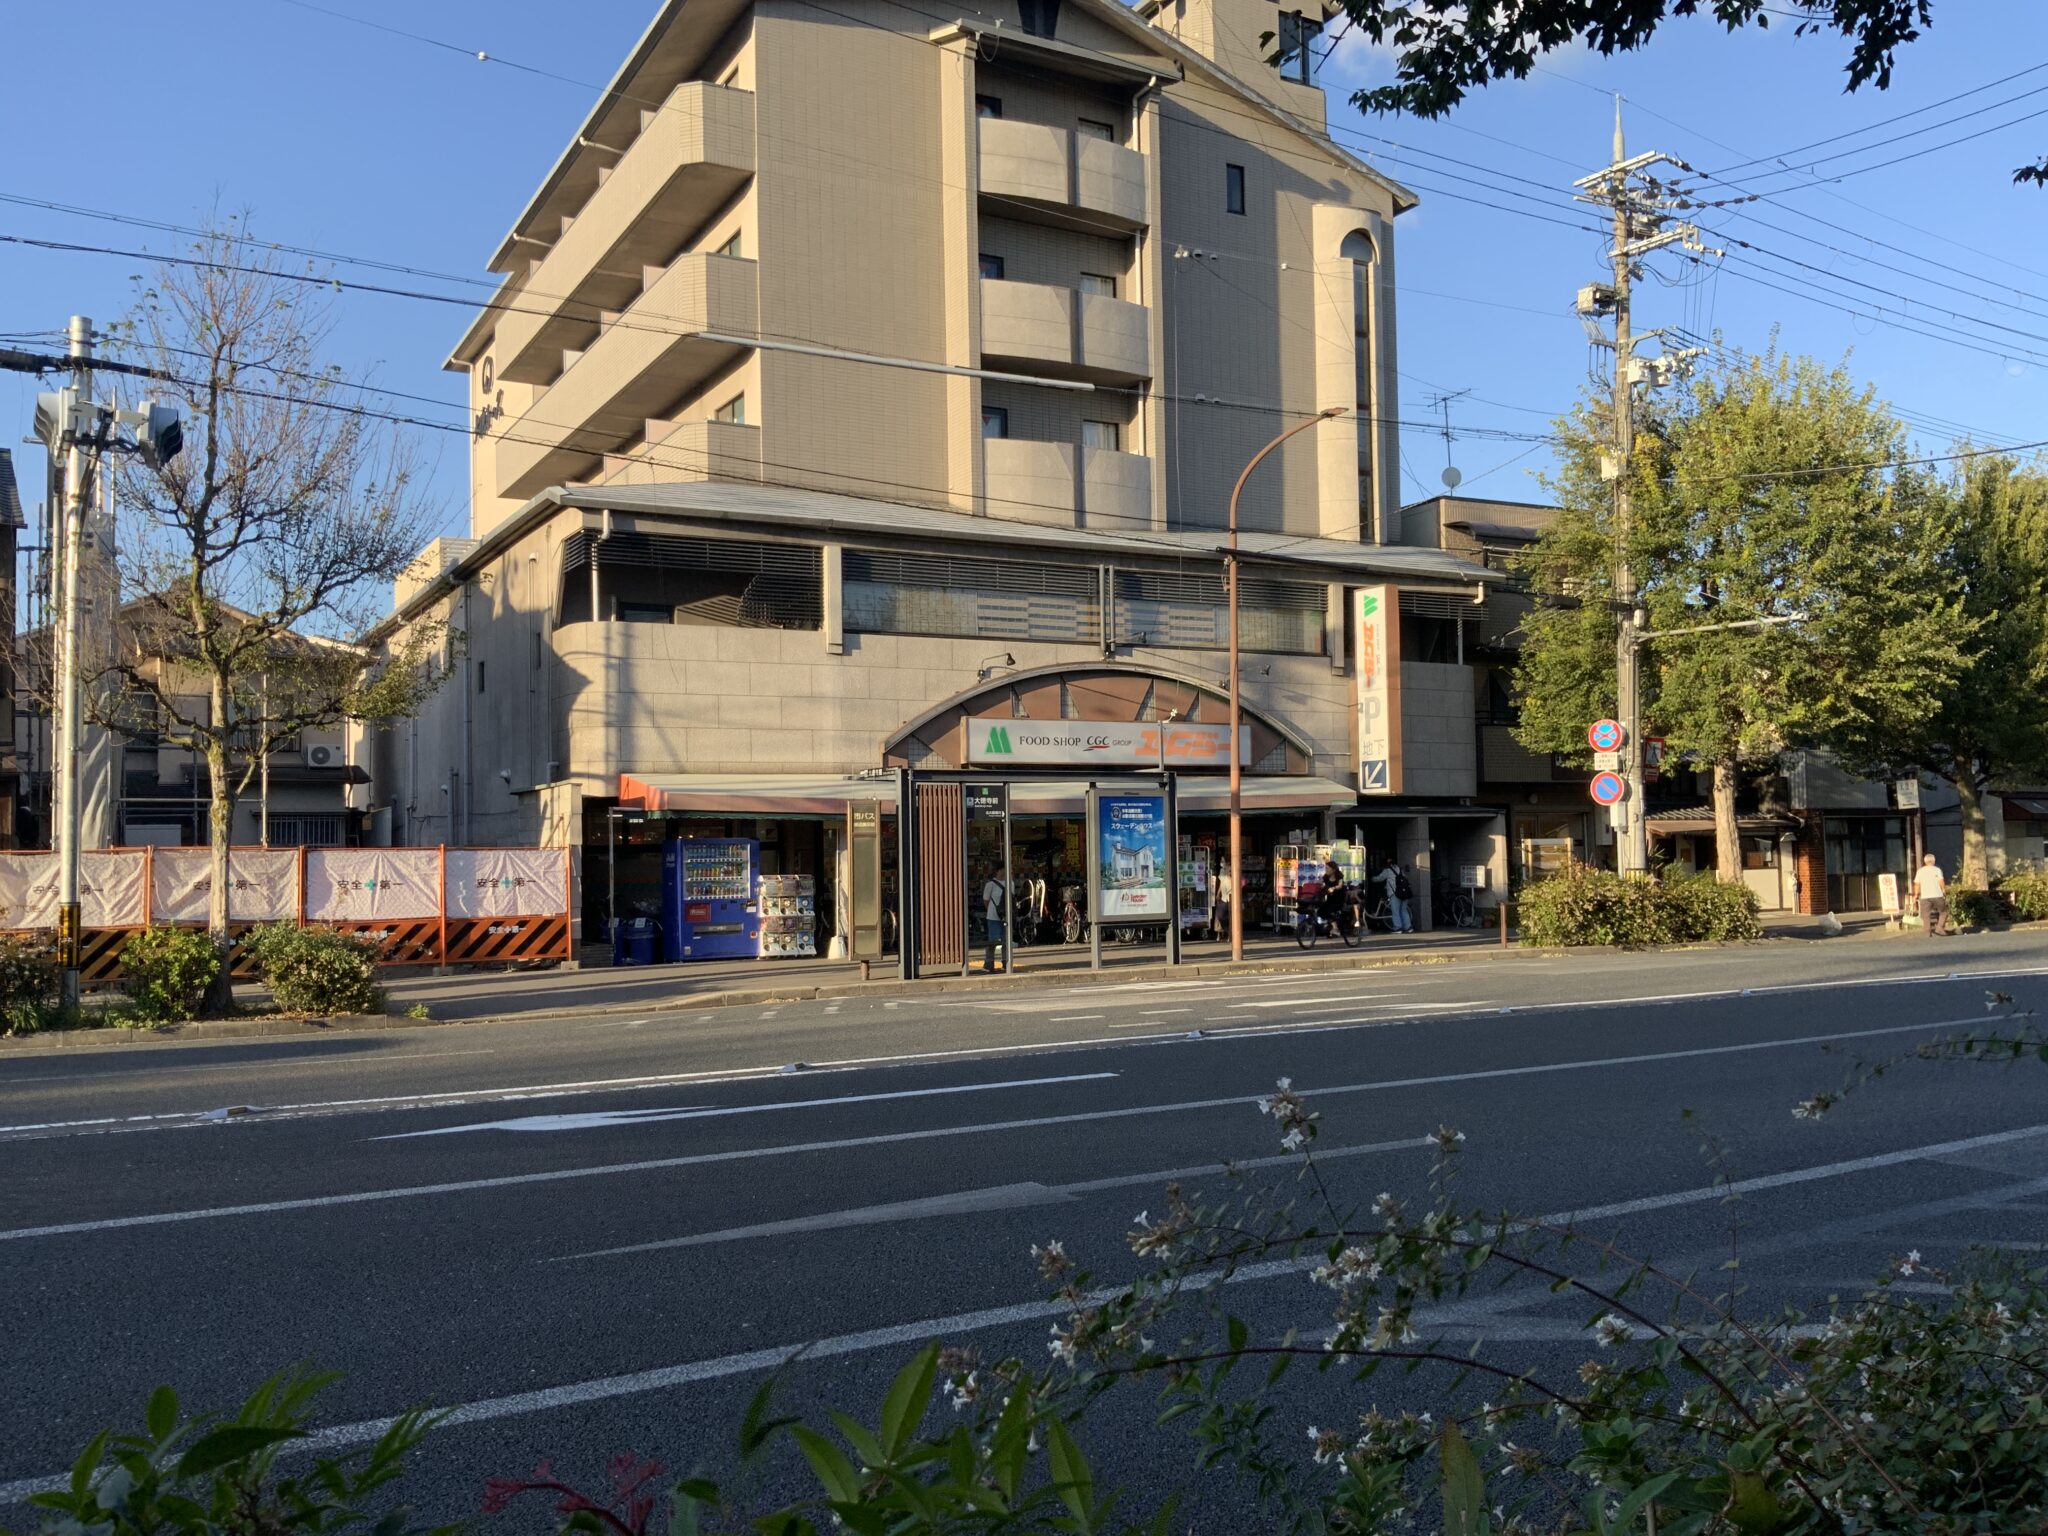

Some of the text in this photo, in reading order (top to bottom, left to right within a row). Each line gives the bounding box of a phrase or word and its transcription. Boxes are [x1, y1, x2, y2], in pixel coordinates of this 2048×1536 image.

[1364, 696, 1381, 735] P
[1019, 736, 1132, 747] FOOD SHOP CGC GROUP
[1362, 739, 1385, 756] 地下
[854, 812, 875, 820] 市バス
[337, 879, 404, 890] 安全 第一
[476, 877, 537, 888] 安全 第一
